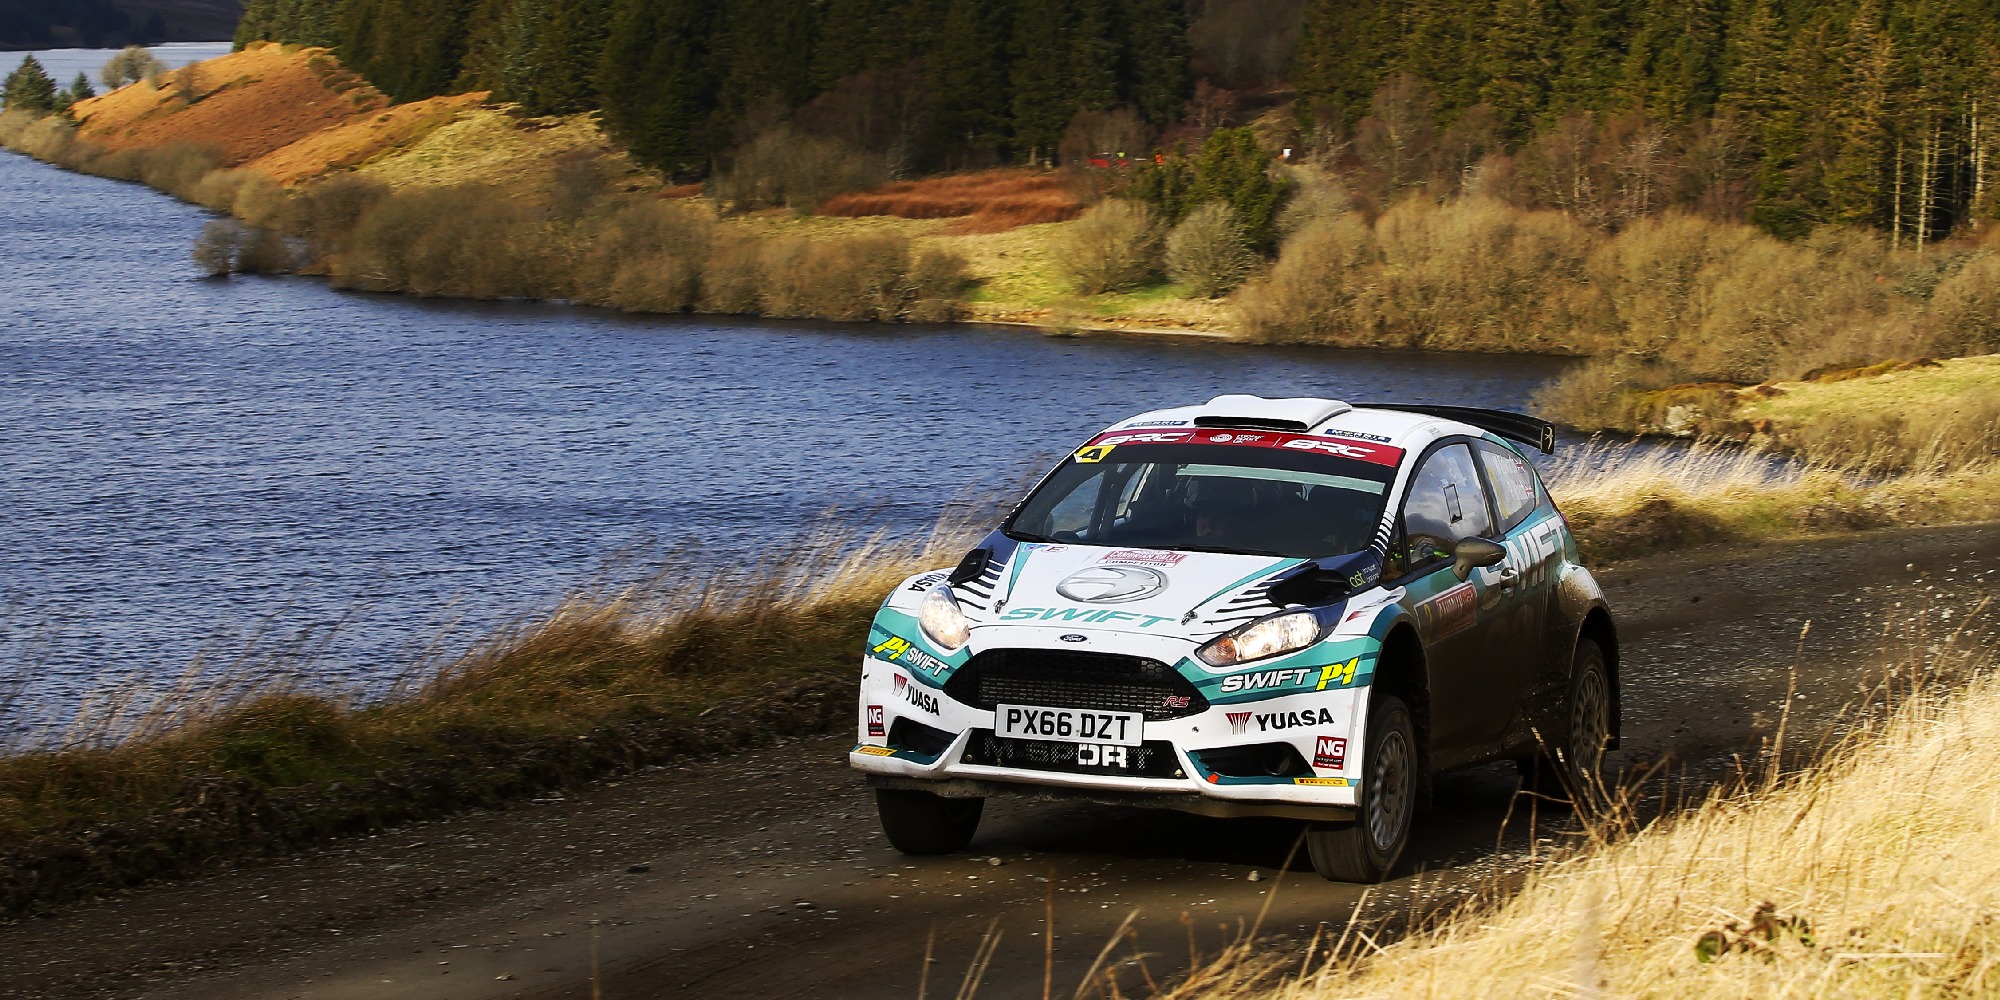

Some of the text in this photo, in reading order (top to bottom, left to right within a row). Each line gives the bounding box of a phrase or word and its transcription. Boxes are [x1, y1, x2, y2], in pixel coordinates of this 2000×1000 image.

[1282, 439, 1377, 458] BRC
[1000, 607, 1176, 628] SWIFT
[906, 647, 949, 676] SWIFT
[1221, 657, 1360, 692] SWIFT P1
[905, 684, 940, 716] YUASA
[868, 708, 883, 724] NG
[1006, 712, 1131, 741] PX66 DZT
[1255, 708, 1335, 732] YUASA
[1317, 739, 1345, 757] NG
